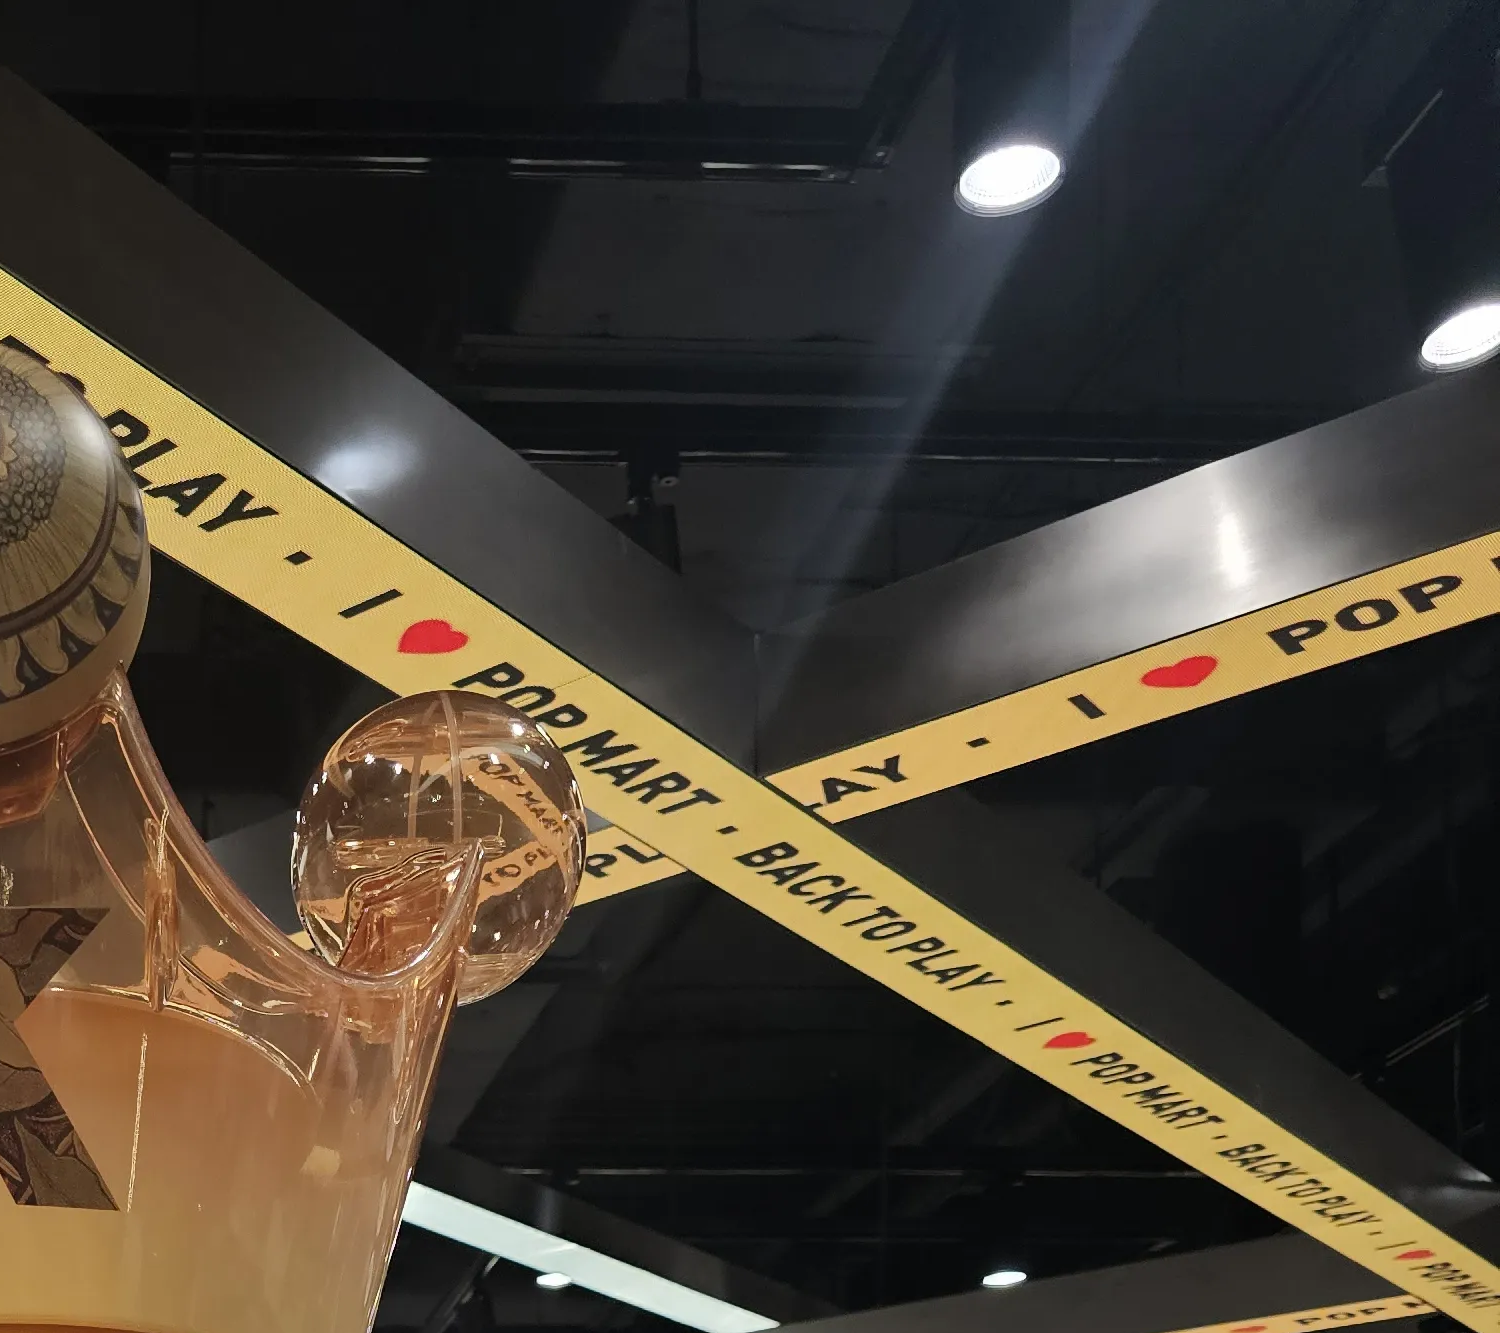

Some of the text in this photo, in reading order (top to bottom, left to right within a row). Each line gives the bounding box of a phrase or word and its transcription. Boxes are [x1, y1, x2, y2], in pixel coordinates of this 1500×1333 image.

[1067, 694, 1107, 720] I
[1266, 575, 1464, 656] POP
[100, 408, 278, 532] PLAY
[338, 588, 403, 618] I
[452, 661, 588, 729] POP
[559, 729, 725, 815] MART
[733, 841, 875, 914] BACK
[841, 905, 917, 941] TO
[885, 936, 1007, 992] PLAY
[1014, 1017, 1064, 1031] I
[1069, 1052, 1155, 1088] POP
[1123, 1084, 1227, 1130] MART
[1217, 1143, 1293, 1186] BACK
[1274, 1170, 1325, 1202] TO
[1312, 1195, 1382, 1229] PLAY
[1292, 1305, 1390, 1328] POP
